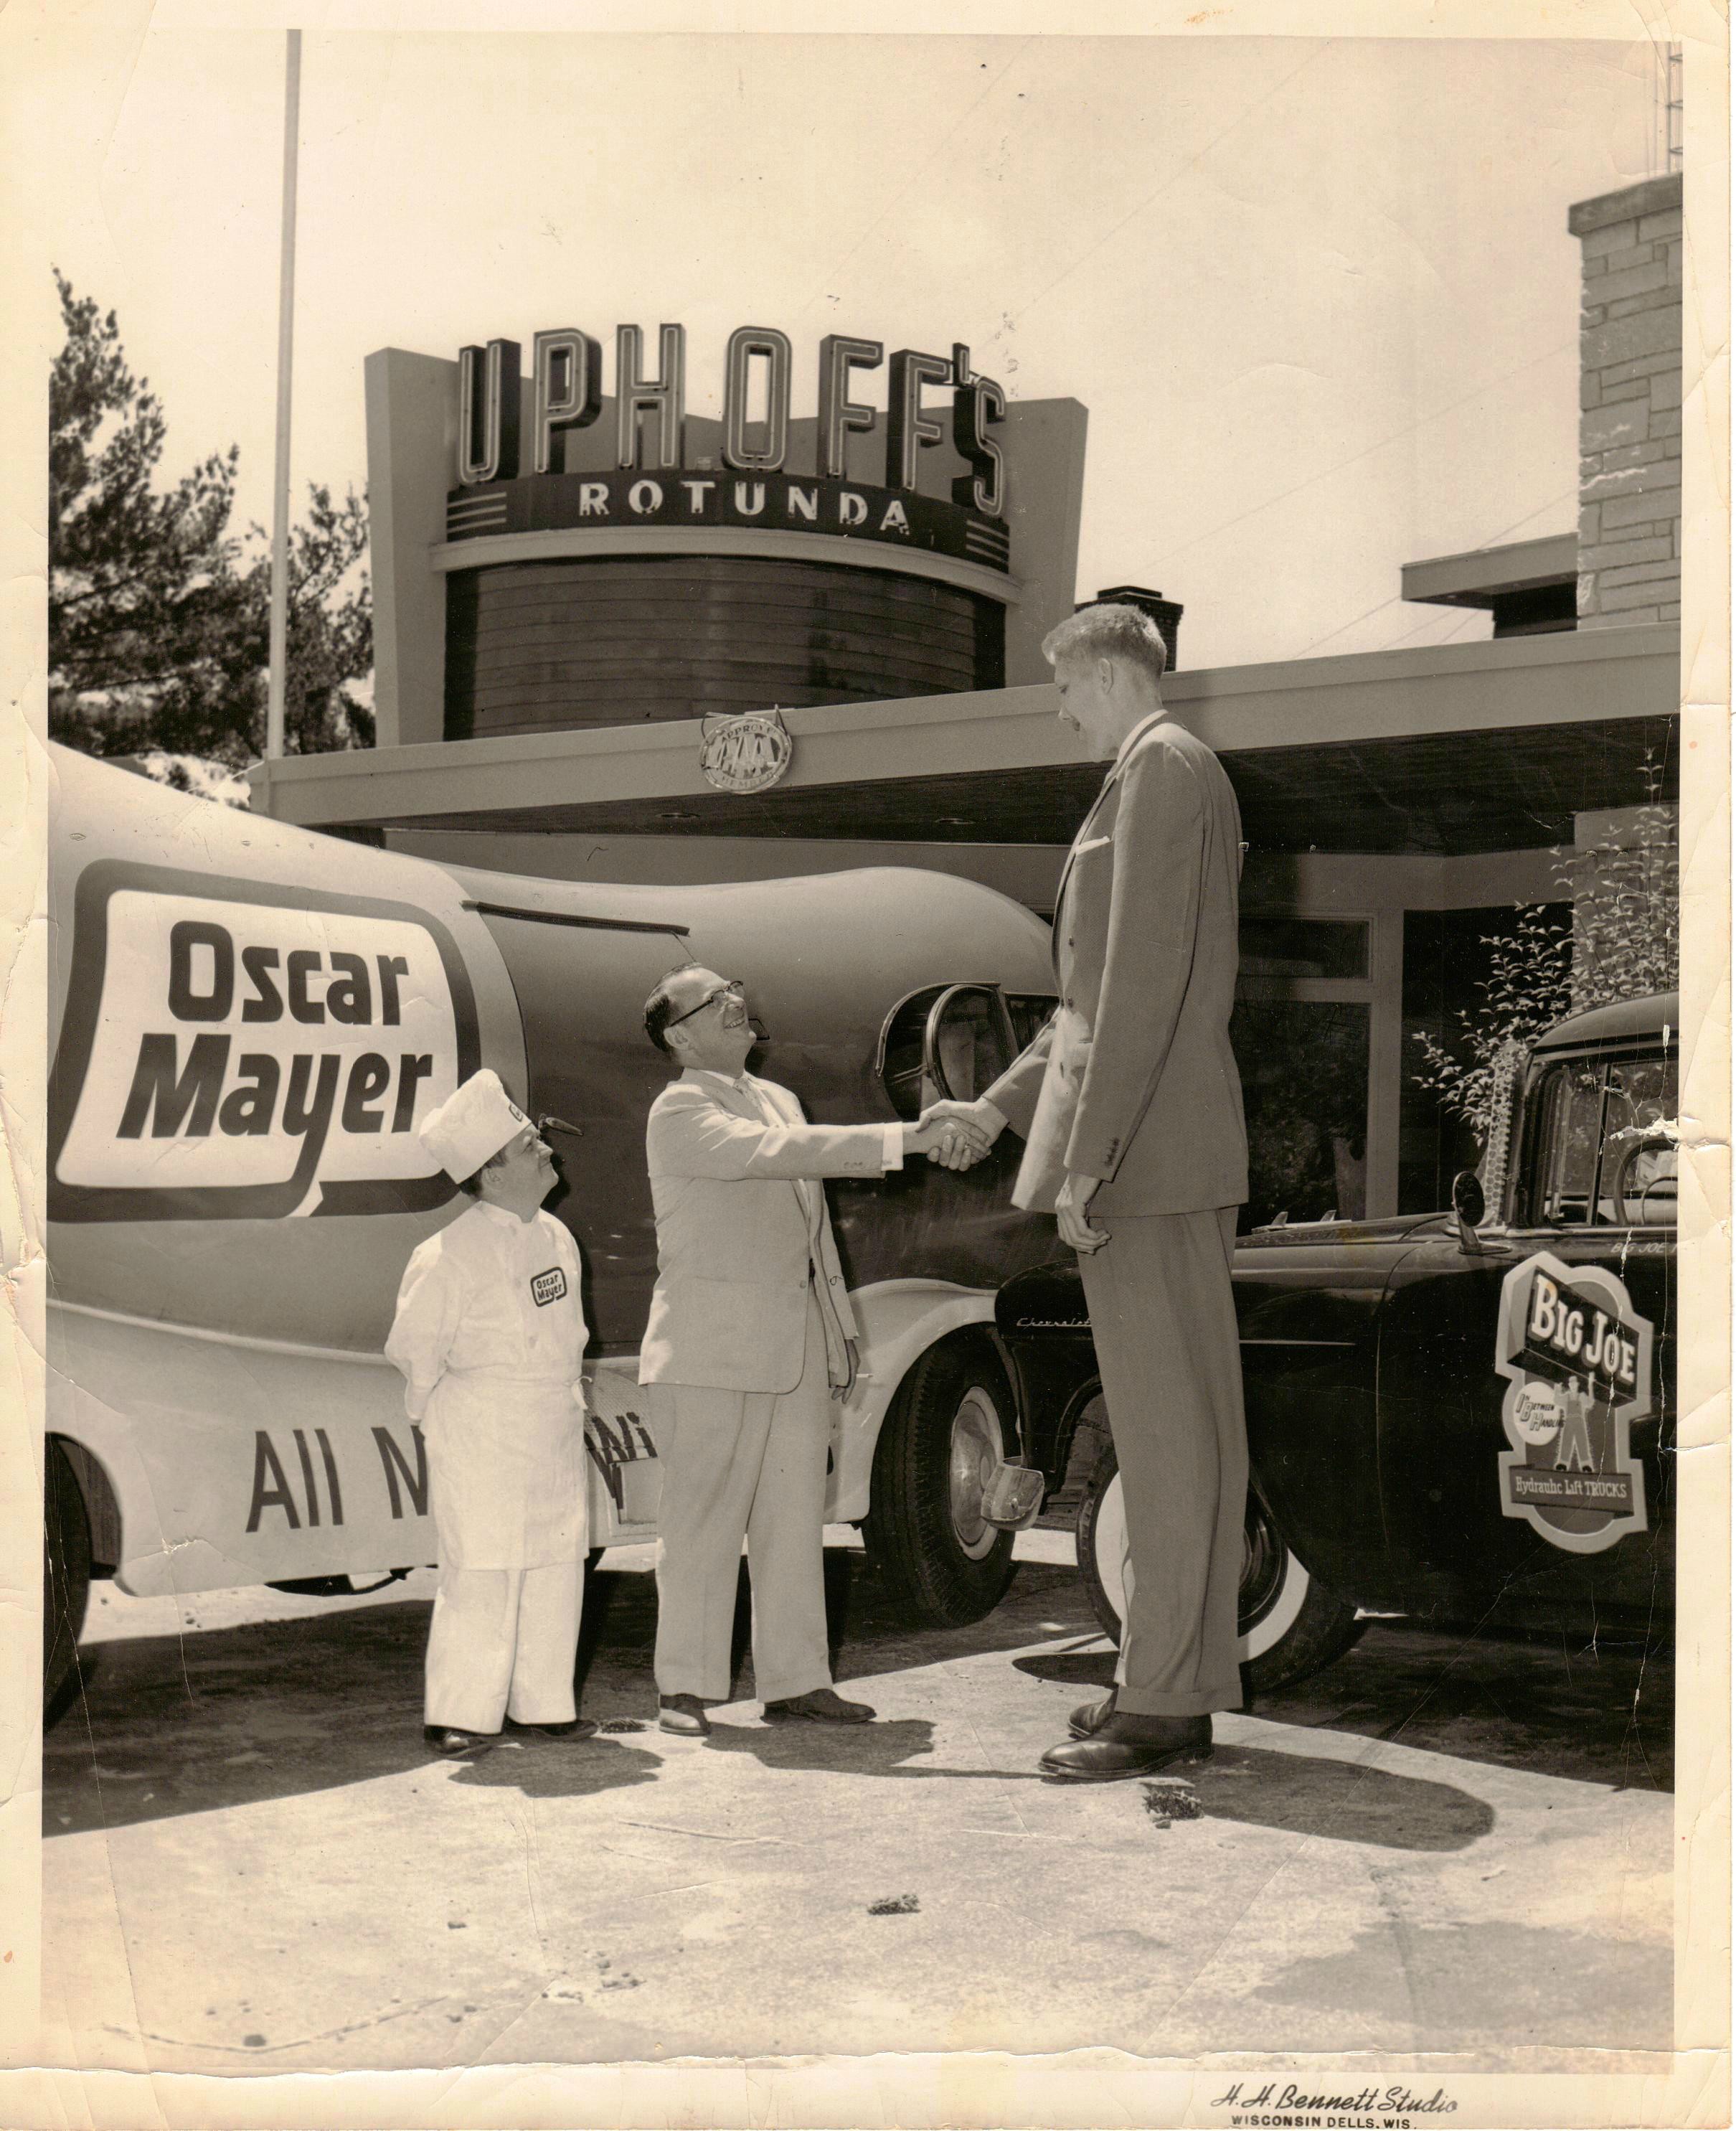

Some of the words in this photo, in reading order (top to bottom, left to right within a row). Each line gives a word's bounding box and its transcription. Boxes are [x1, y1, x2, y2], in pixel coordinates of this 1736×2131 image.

[458, 322, 1005, 519] UPHOFF'S
[578, 479, 911, 536] ROTUNDA
[168, 920, 409, 1026] Oscar
[115, 1032, 433, 1187] Mayer
[537, 1274, 558, 1289] Oscar
[1610, 1242, 1637, 1253] BG
[1638, 1242, 1669, 1253] JOE
[537, 1284, 562, 1301] Mayer
[1530, 1273, 1584, 1355] BIG
[1585, 1310, 1636, 1384] JOE
[245, 1428, 344, 1533] All
[1515, 1476, 1563, 1495] Hydraulic
[1565, 1479, 1583, 1495] Lift
[1584, 1481, 1628, 1498] TRUCKS
